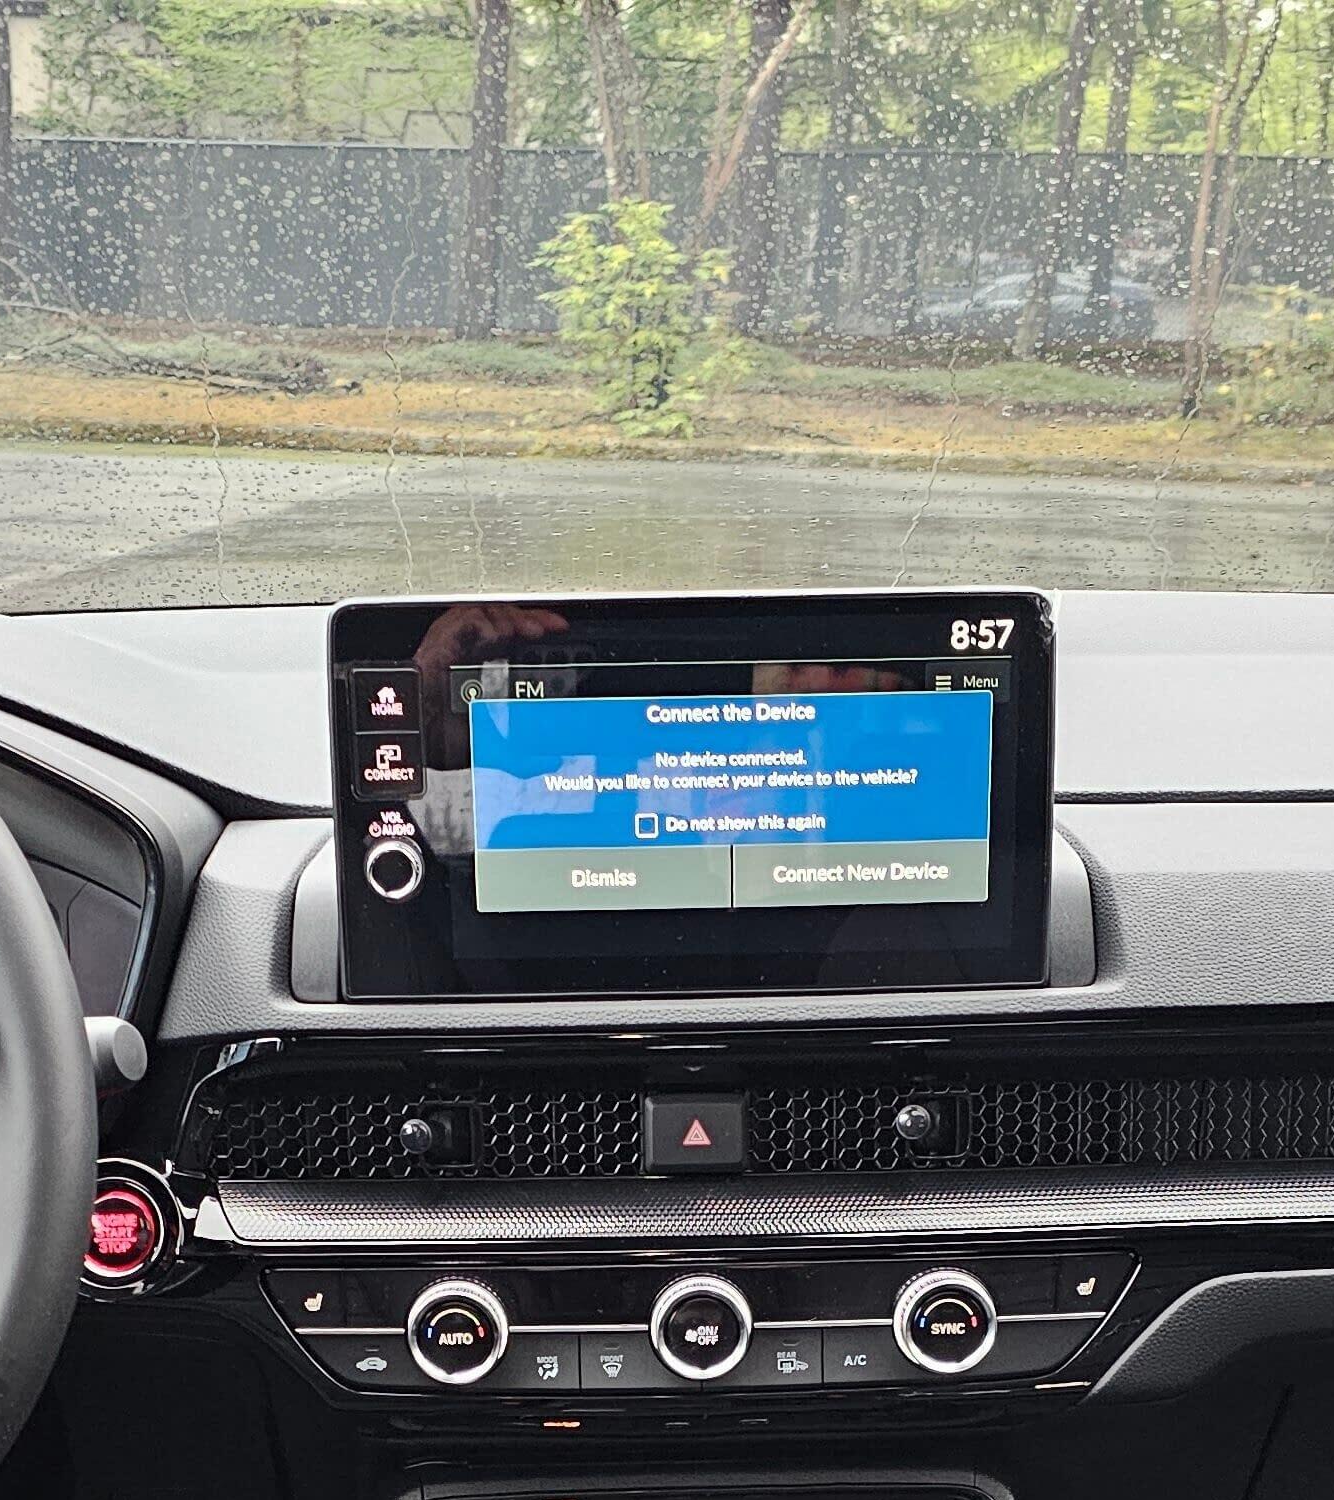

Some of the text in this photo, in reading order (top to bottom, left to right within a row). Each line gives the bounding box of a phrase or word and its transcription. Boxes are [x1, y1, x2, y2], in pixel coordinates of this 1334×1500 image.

[951, 619, 1015, 650] 8:57
[963, 675, 999, 688] Menu
[515, 681, 544, 698] FM
[371, 703, 404, 716] HOME
[646, 703, 816, 723] Connect the Device
[655, 749, 808, 768] No device connected.
[364, 768, 415, 781] CONNECT
[544, 768, 919, 793] Would you like to connect your device to the vehicle?
[380, 811, 403, 824] VOL
[665, 813, 826, 832] Do not show this again
[382, 823, 416, 836] AUDIO
[571, 869, 637, 888] Dismiss
[772, 862, 950, 884] Connect New Device
[94, 1226, 135, 1239] START
[98, 1241, 132, 1254] STOP
[697, 1326, 719, 1337] ON/
[931, 1322, 966, 1335] SYNC
[438, 1332, 474, 1346] AUTO
[697, 1336, 719, 1346] OFF
[536, 1356, 558, 1364] MODE
[600, 1354, 624, 1363] FRONT
[843, 1354, 867, 1367] A/C
